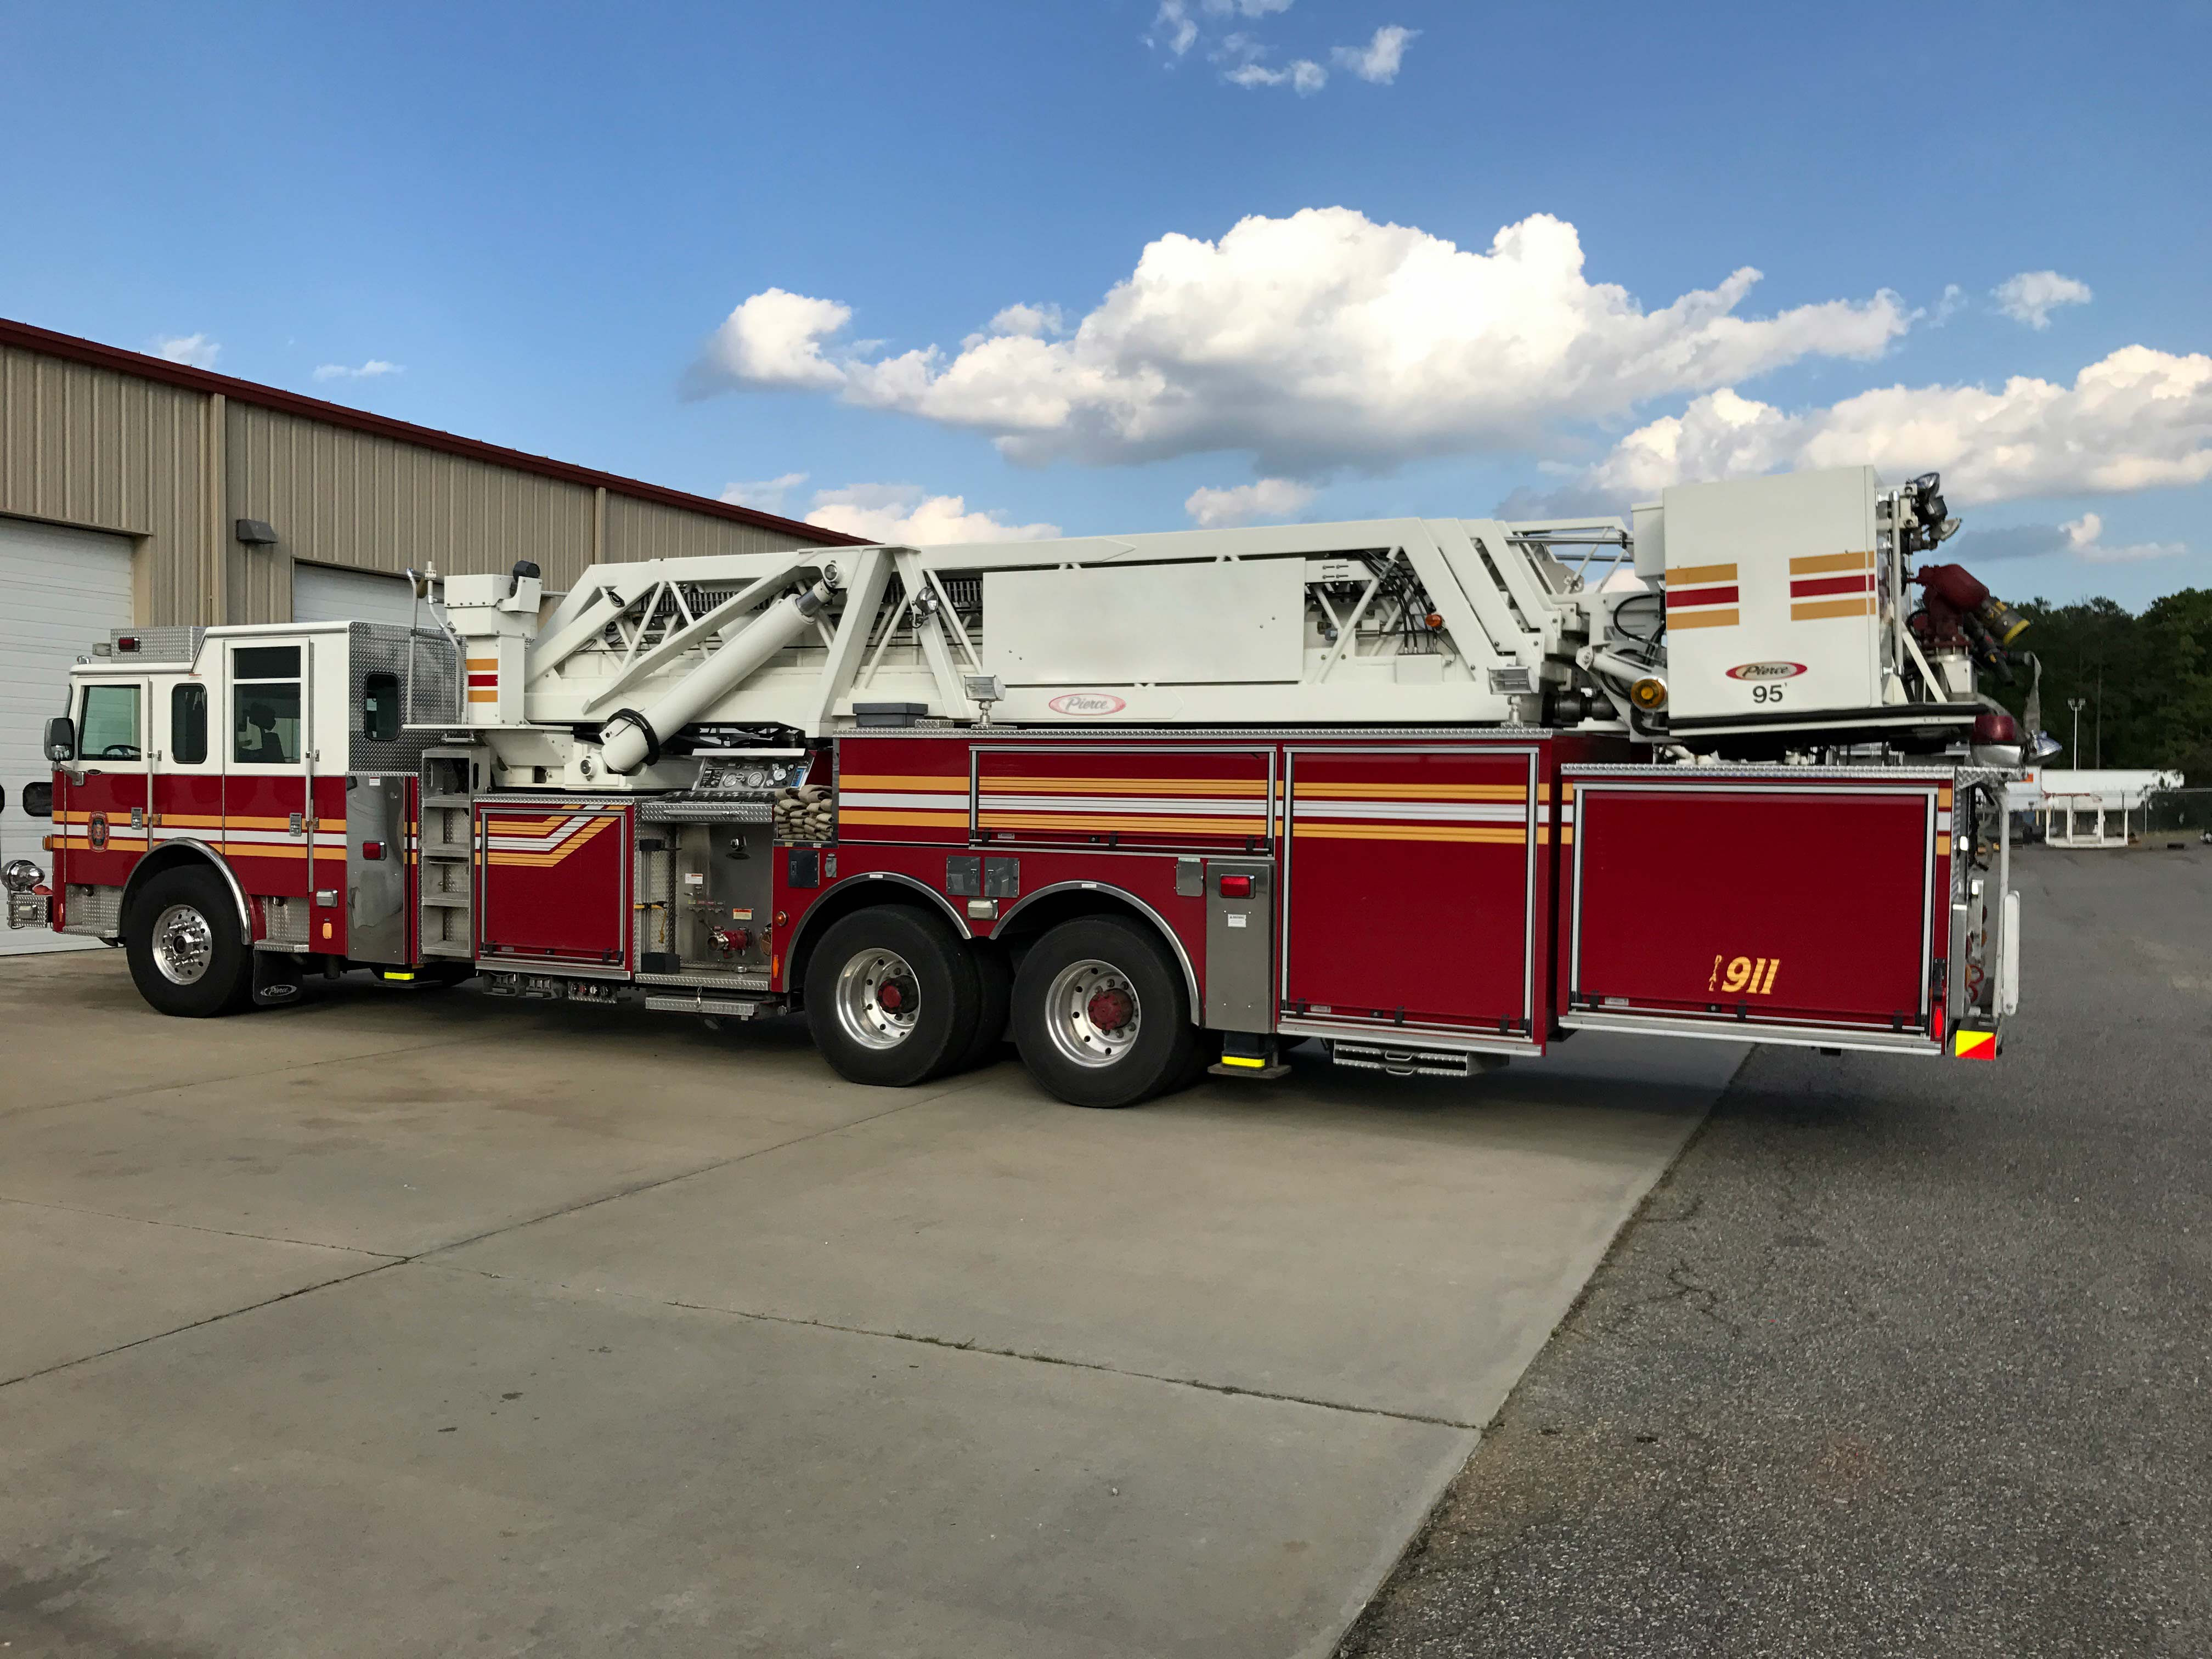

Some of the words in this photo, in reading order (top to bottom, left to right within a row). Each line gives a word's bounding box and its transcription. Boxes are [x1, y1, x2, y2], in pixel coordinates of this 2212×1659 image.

[1742, 665, 1788, 678] Pierce
[1065, 696, 1107, 711] Pierce
[1721, 956, 1780, 995] 911
